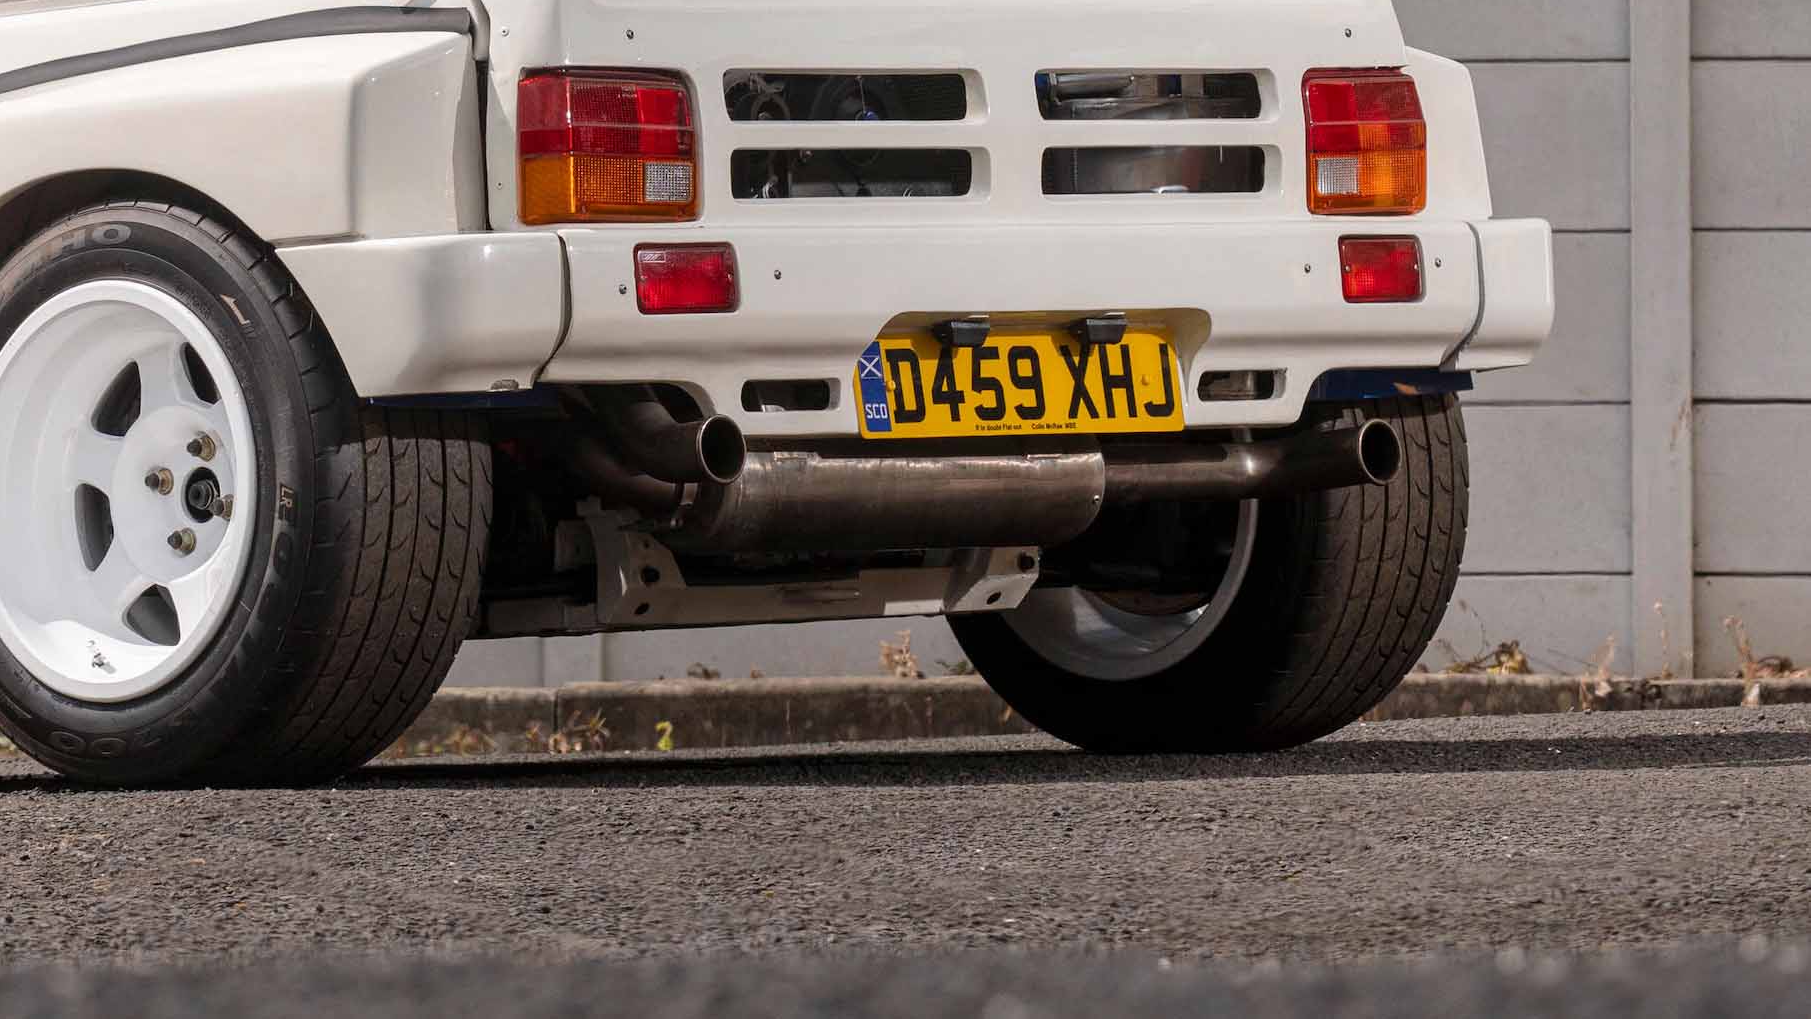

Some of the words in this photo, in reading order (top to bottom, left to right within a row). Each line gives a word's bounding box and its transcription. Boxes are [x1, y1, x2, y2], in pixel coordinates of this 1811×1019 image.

[885, 344, 1046, 424] D459
[1060, 342, 1176, 420] XHJ
[864, 402, 889, 420] SCO
